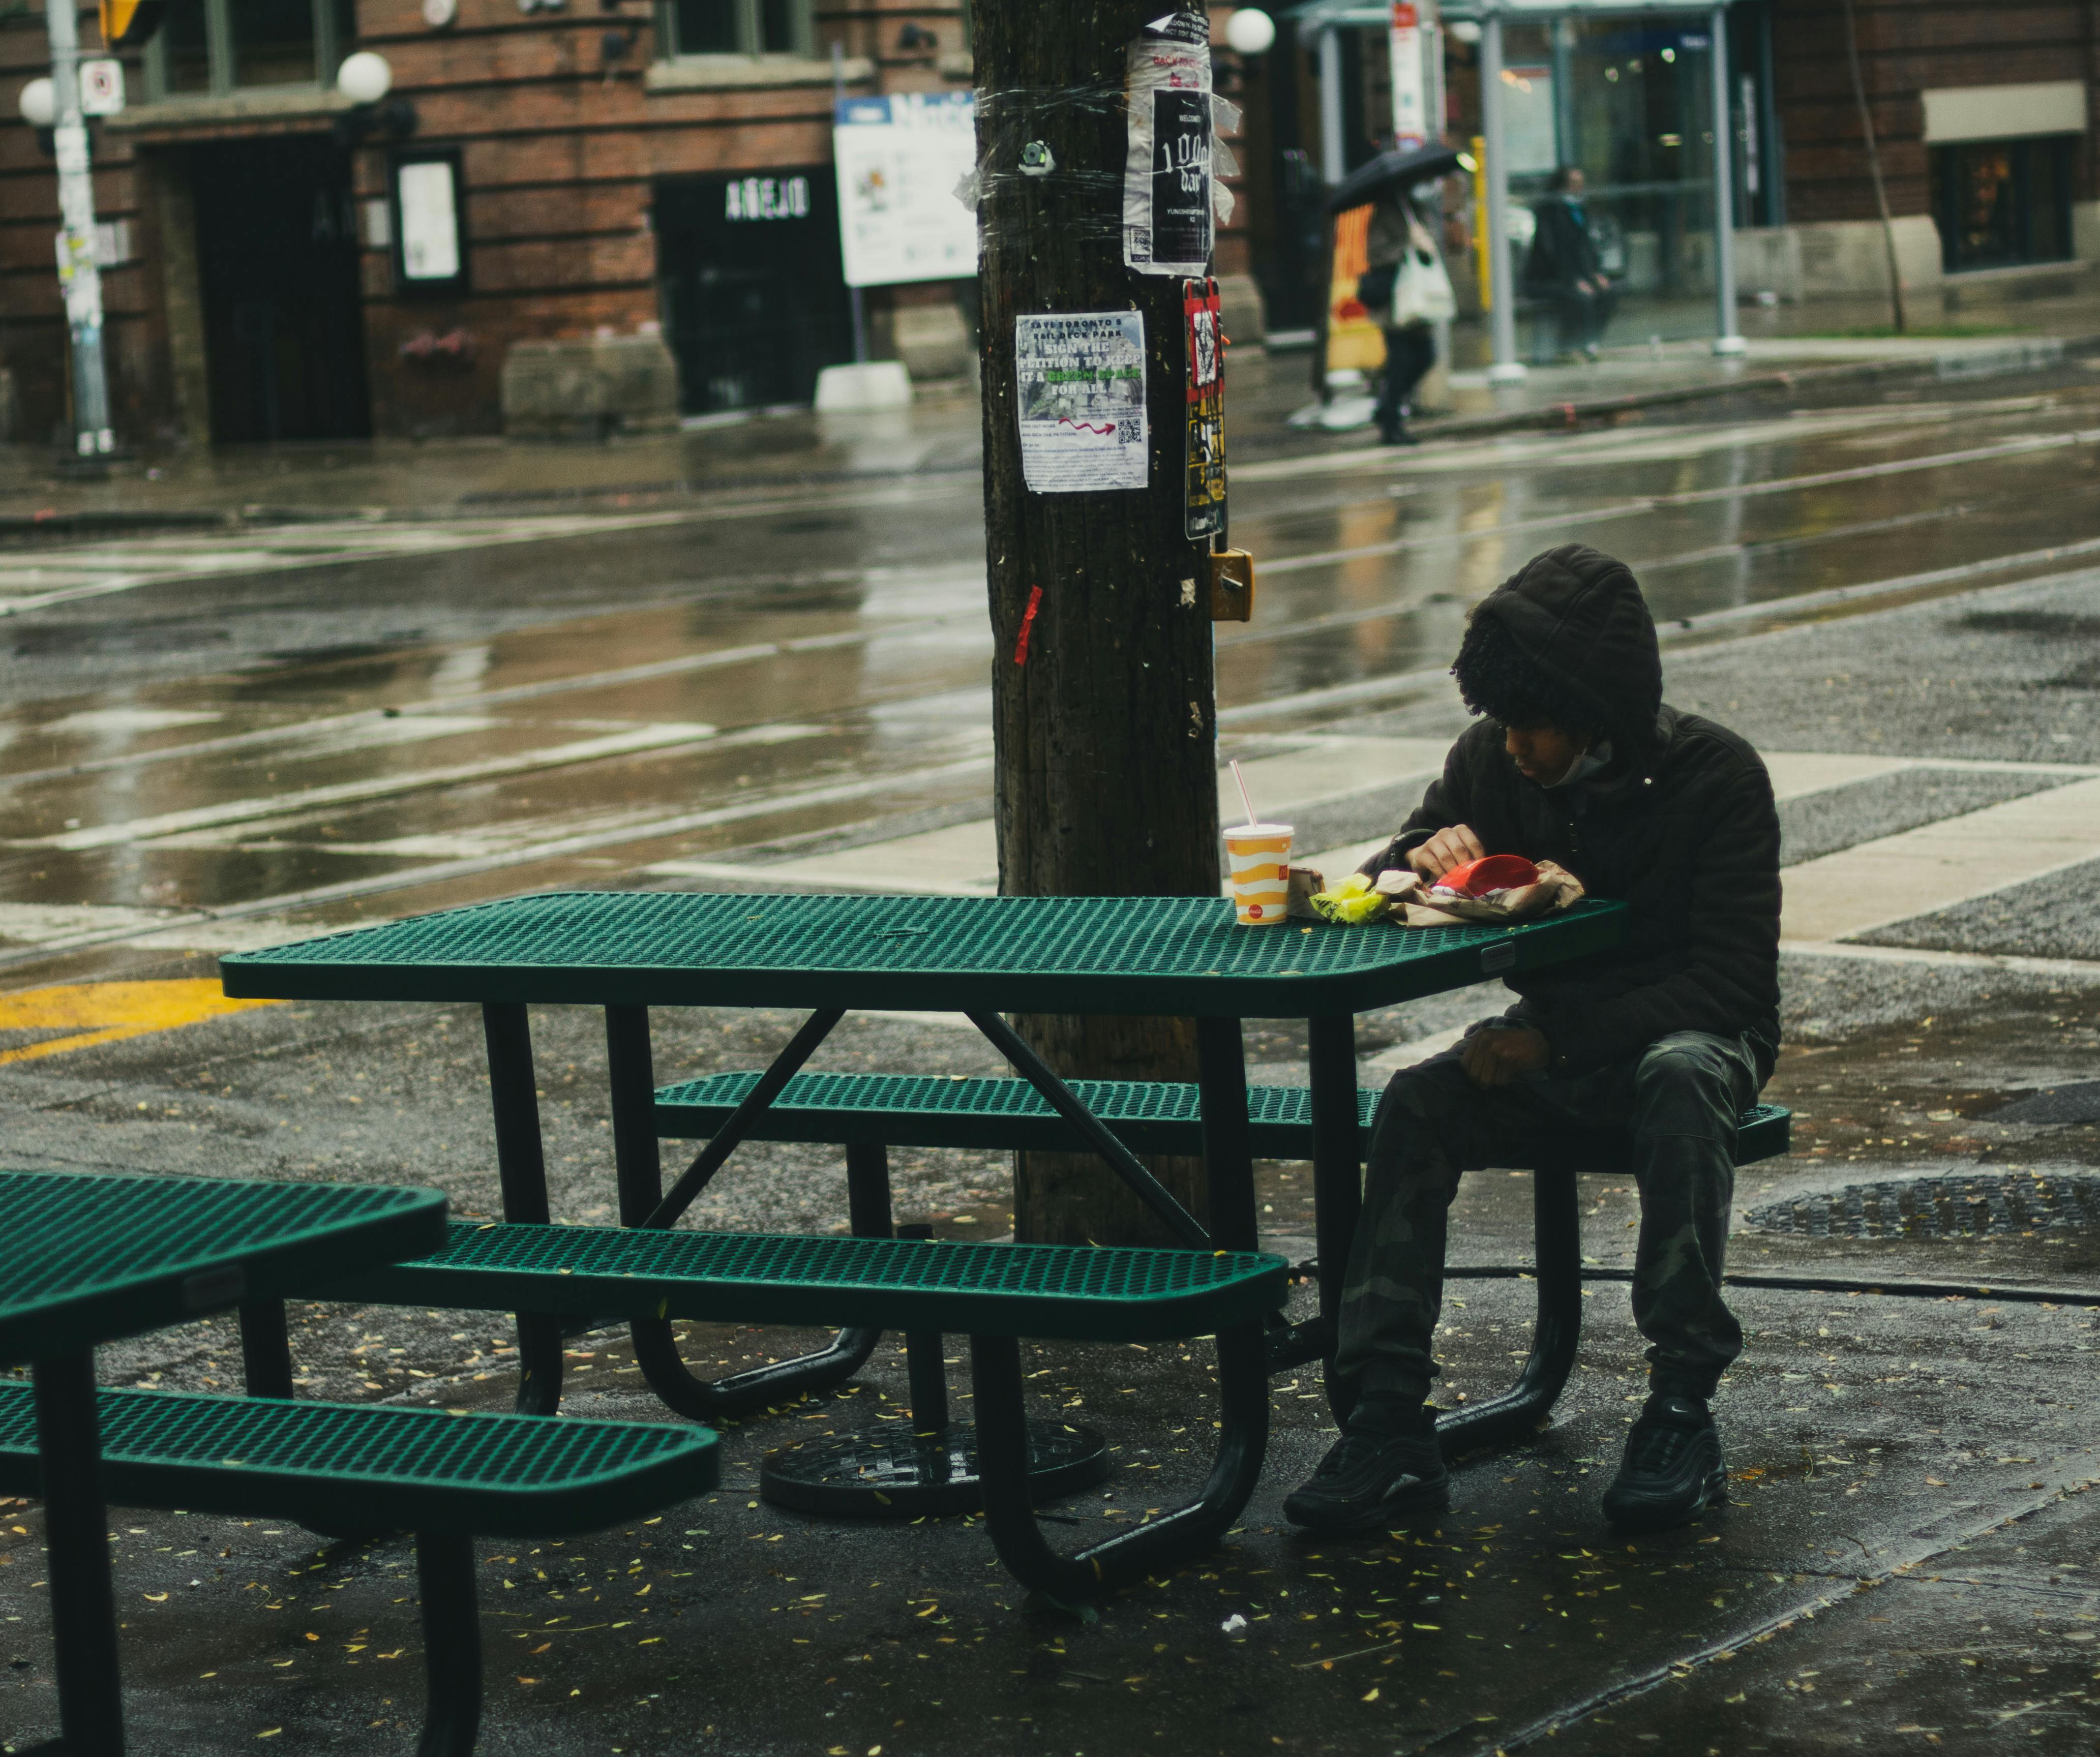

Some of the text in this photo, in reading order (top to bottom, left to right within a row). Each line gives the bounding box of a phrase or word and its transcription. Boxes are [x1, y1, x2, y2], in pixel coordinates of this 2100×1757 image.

[1093, 330, 1122, 338] PARK
[1045, 342, 1110, 355] SIGN THE
[1019, 354, 1141, 369] PETITION TO KEEP
[1021, 368, 1142, 382] IT A GREEN SPACE
[1051, 383, 1107, 396] FOR ALL
